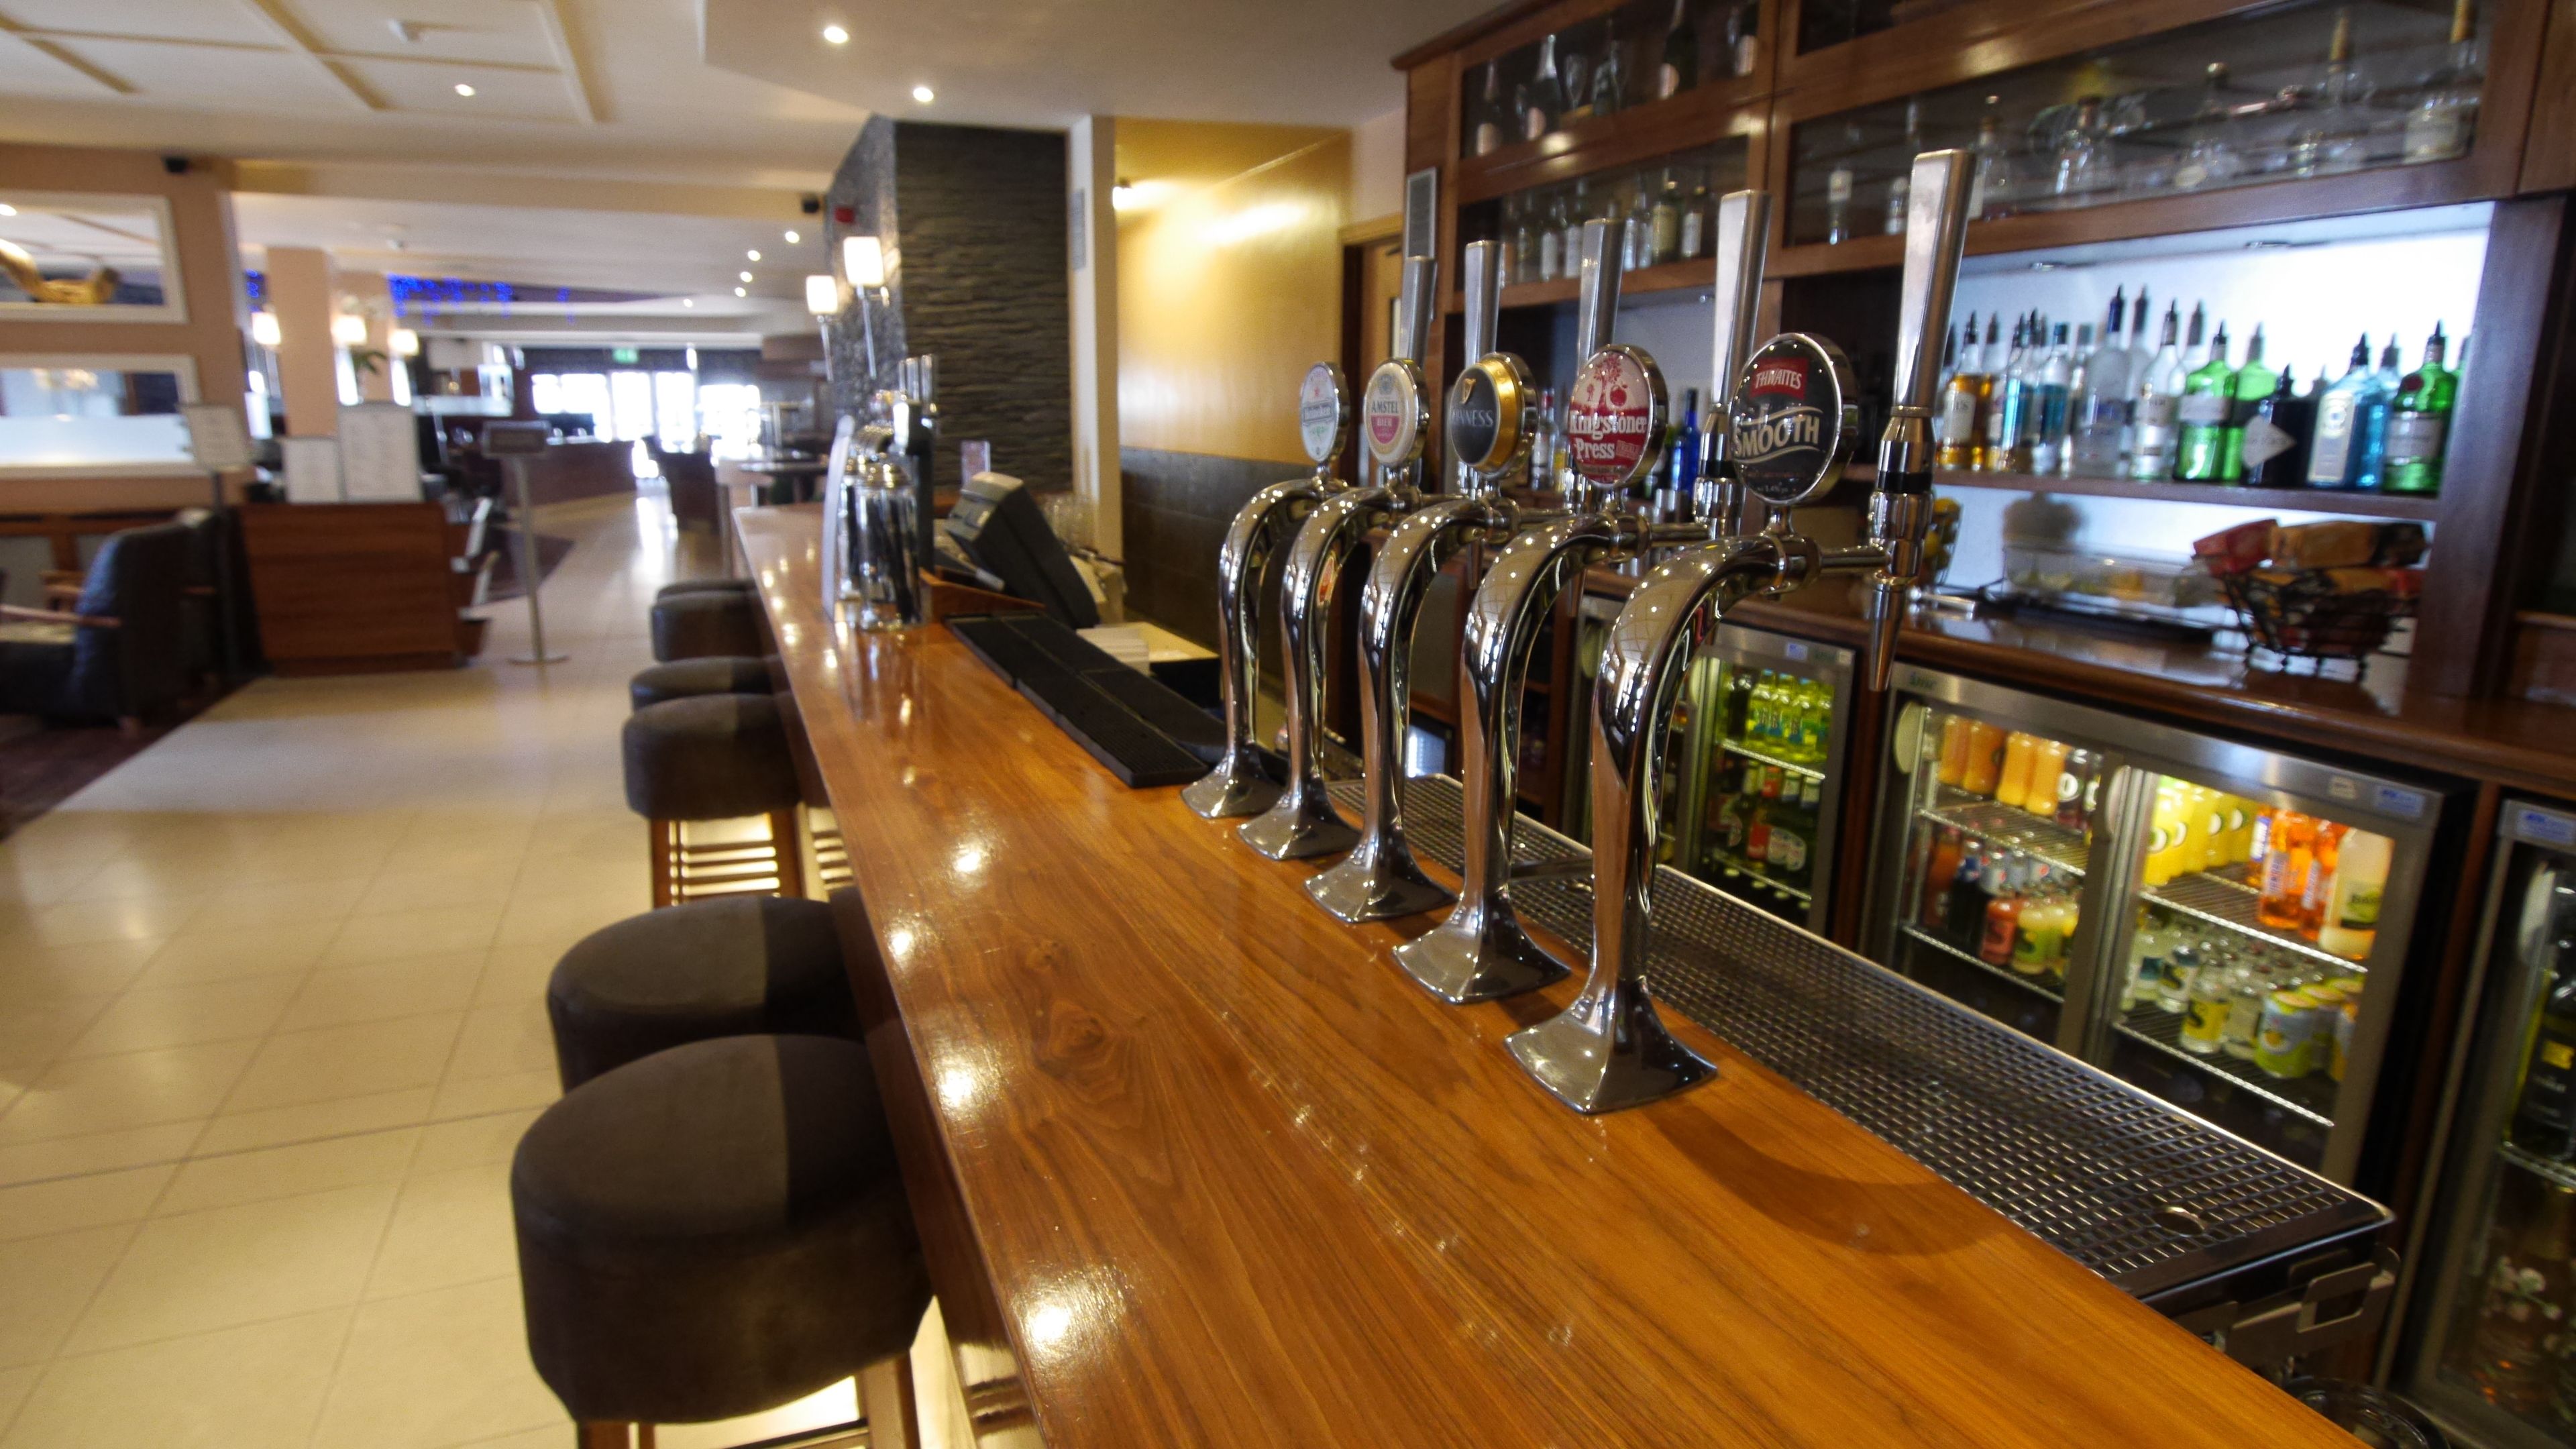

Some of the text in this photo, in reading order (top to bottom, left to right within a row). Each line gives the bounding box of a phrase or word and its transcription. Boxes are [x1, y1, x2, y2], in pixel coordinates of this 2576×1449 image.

[1755, 368, 1803, 390] THWAITES
[1371, 400, 1399, 413] AMSTEL
[1733, 415, 1821, 458] SMOOTH
[1575, 437, 1615, 460] Press
